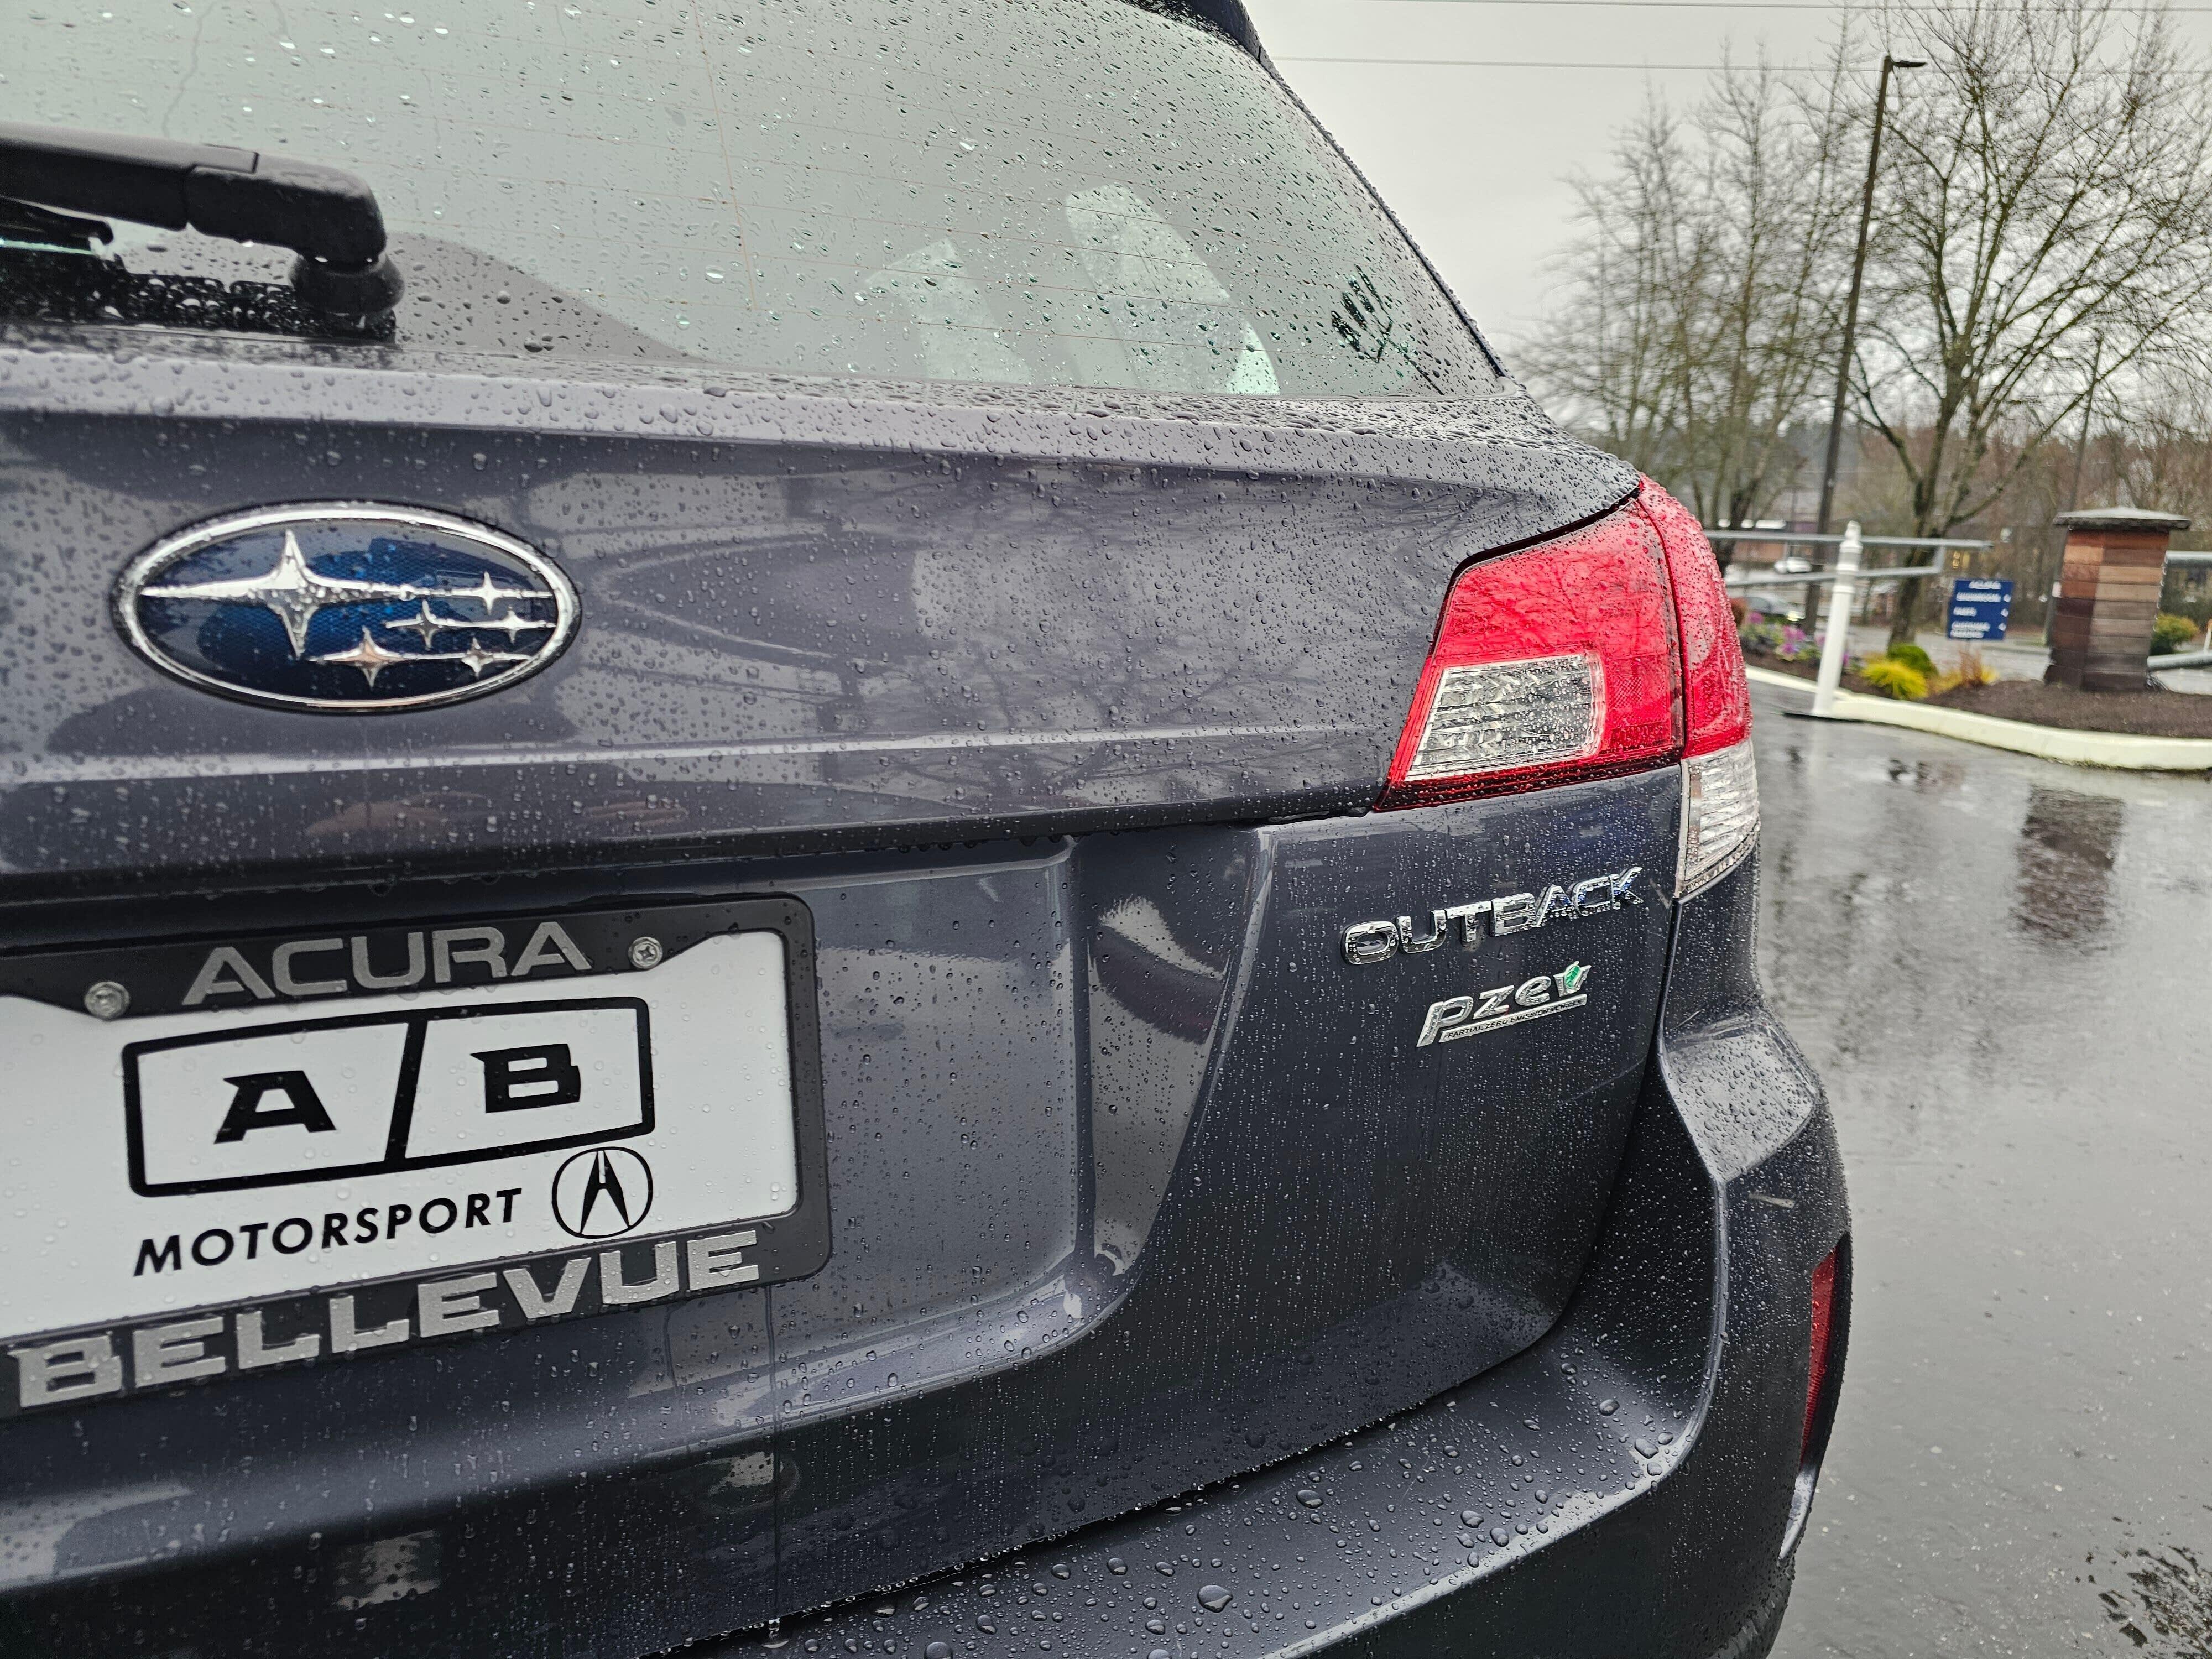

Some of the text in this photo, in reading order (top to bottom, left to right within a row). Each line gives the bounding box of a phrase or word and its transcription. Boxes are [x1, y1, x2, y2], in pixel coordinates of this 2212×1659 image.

[182, 921, 593, 1006] ACURA
[1341, 867, 1645, 966] OUTBACK
[1485, 1019, 1509, 1030] ZERO
[1510, 1009, 1550, 1023] EMISSION
[213, 1043, 581, 1144] A B
[133, 1187, 523, 1277] MOTORSPORT
[7, 1230, 760, 1408] BELLEVUE
